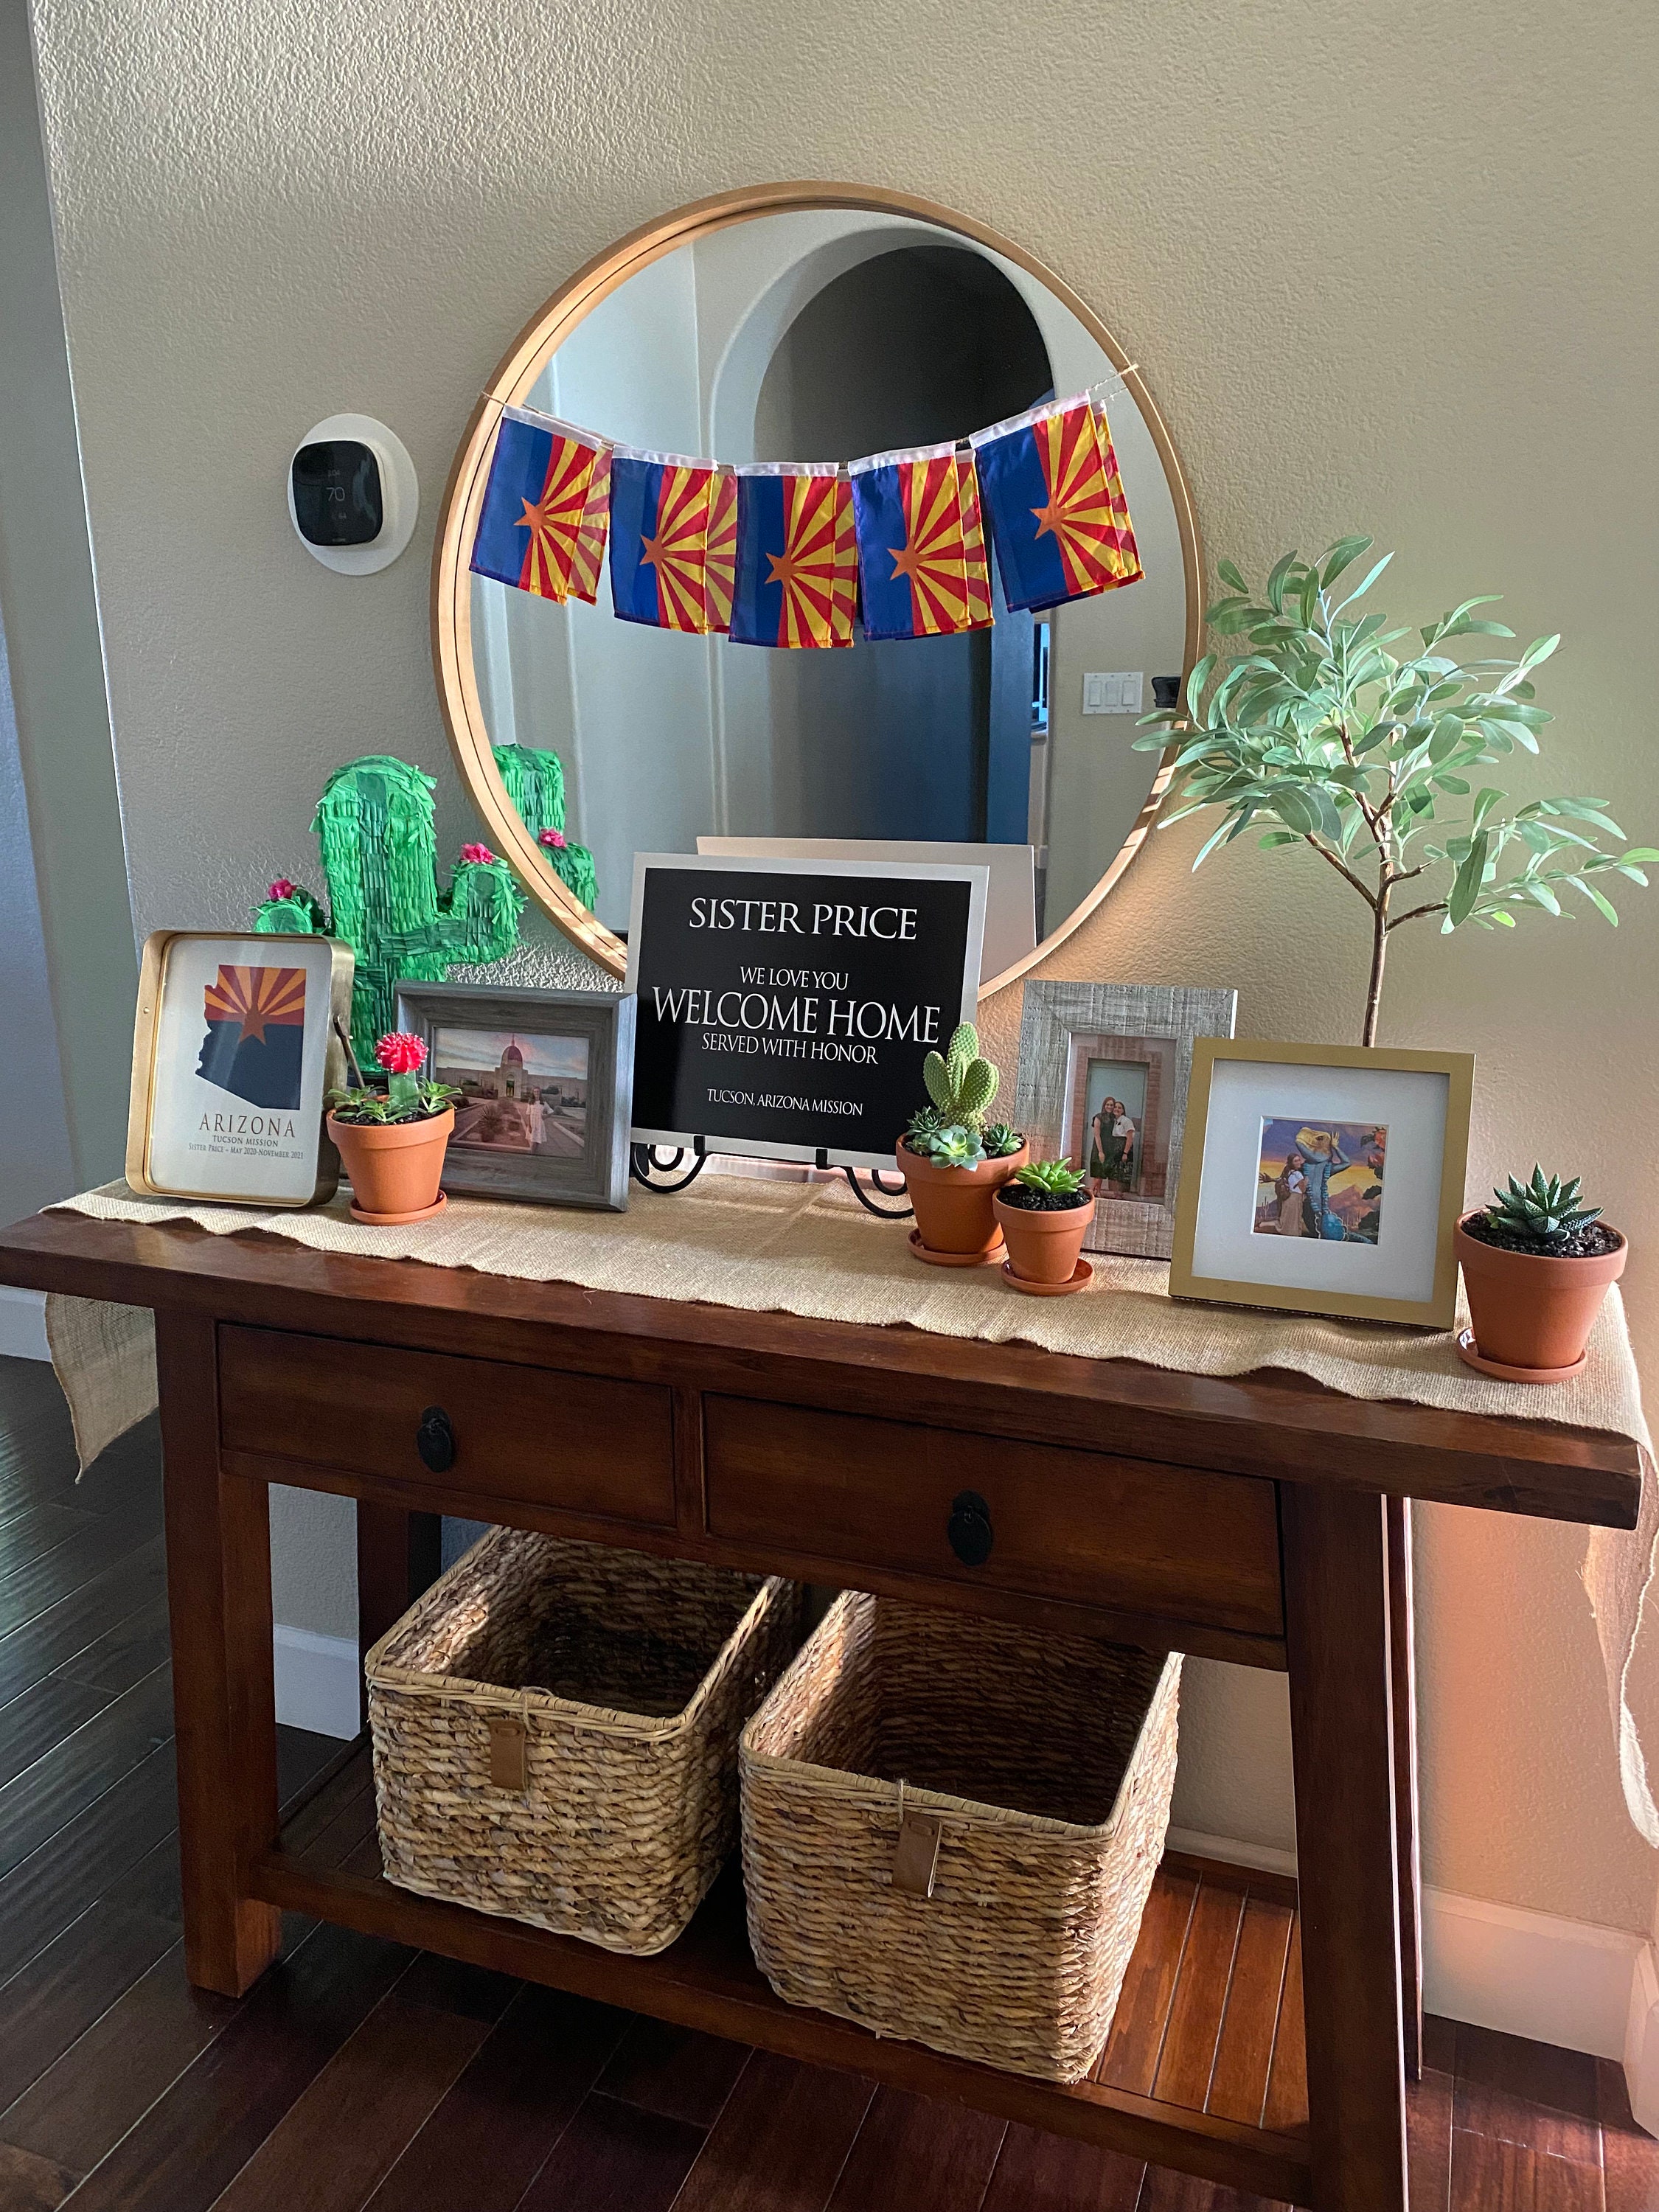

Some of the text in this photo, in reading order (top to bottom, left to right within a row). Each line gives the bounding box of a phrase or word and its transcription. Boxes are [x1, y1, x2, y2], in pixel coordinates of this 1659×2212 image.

[327, 486, 345, 501] 70
[689, 897, 917, 940] SISTER PRICE
[740, 966, 849, 990] WE LOVE YOU
[652, 987, 941, 1043] WELCOME HOME
[702, 1032, 878, 1065] SERVED WITH HONOR
[707, 1088, 863, 1116] TUCSON, ARIZONA MISSION
[199, 1113, 296, 1138] ARIZONA
[213, 1135, 278, 1147] TUCSON MISSION
